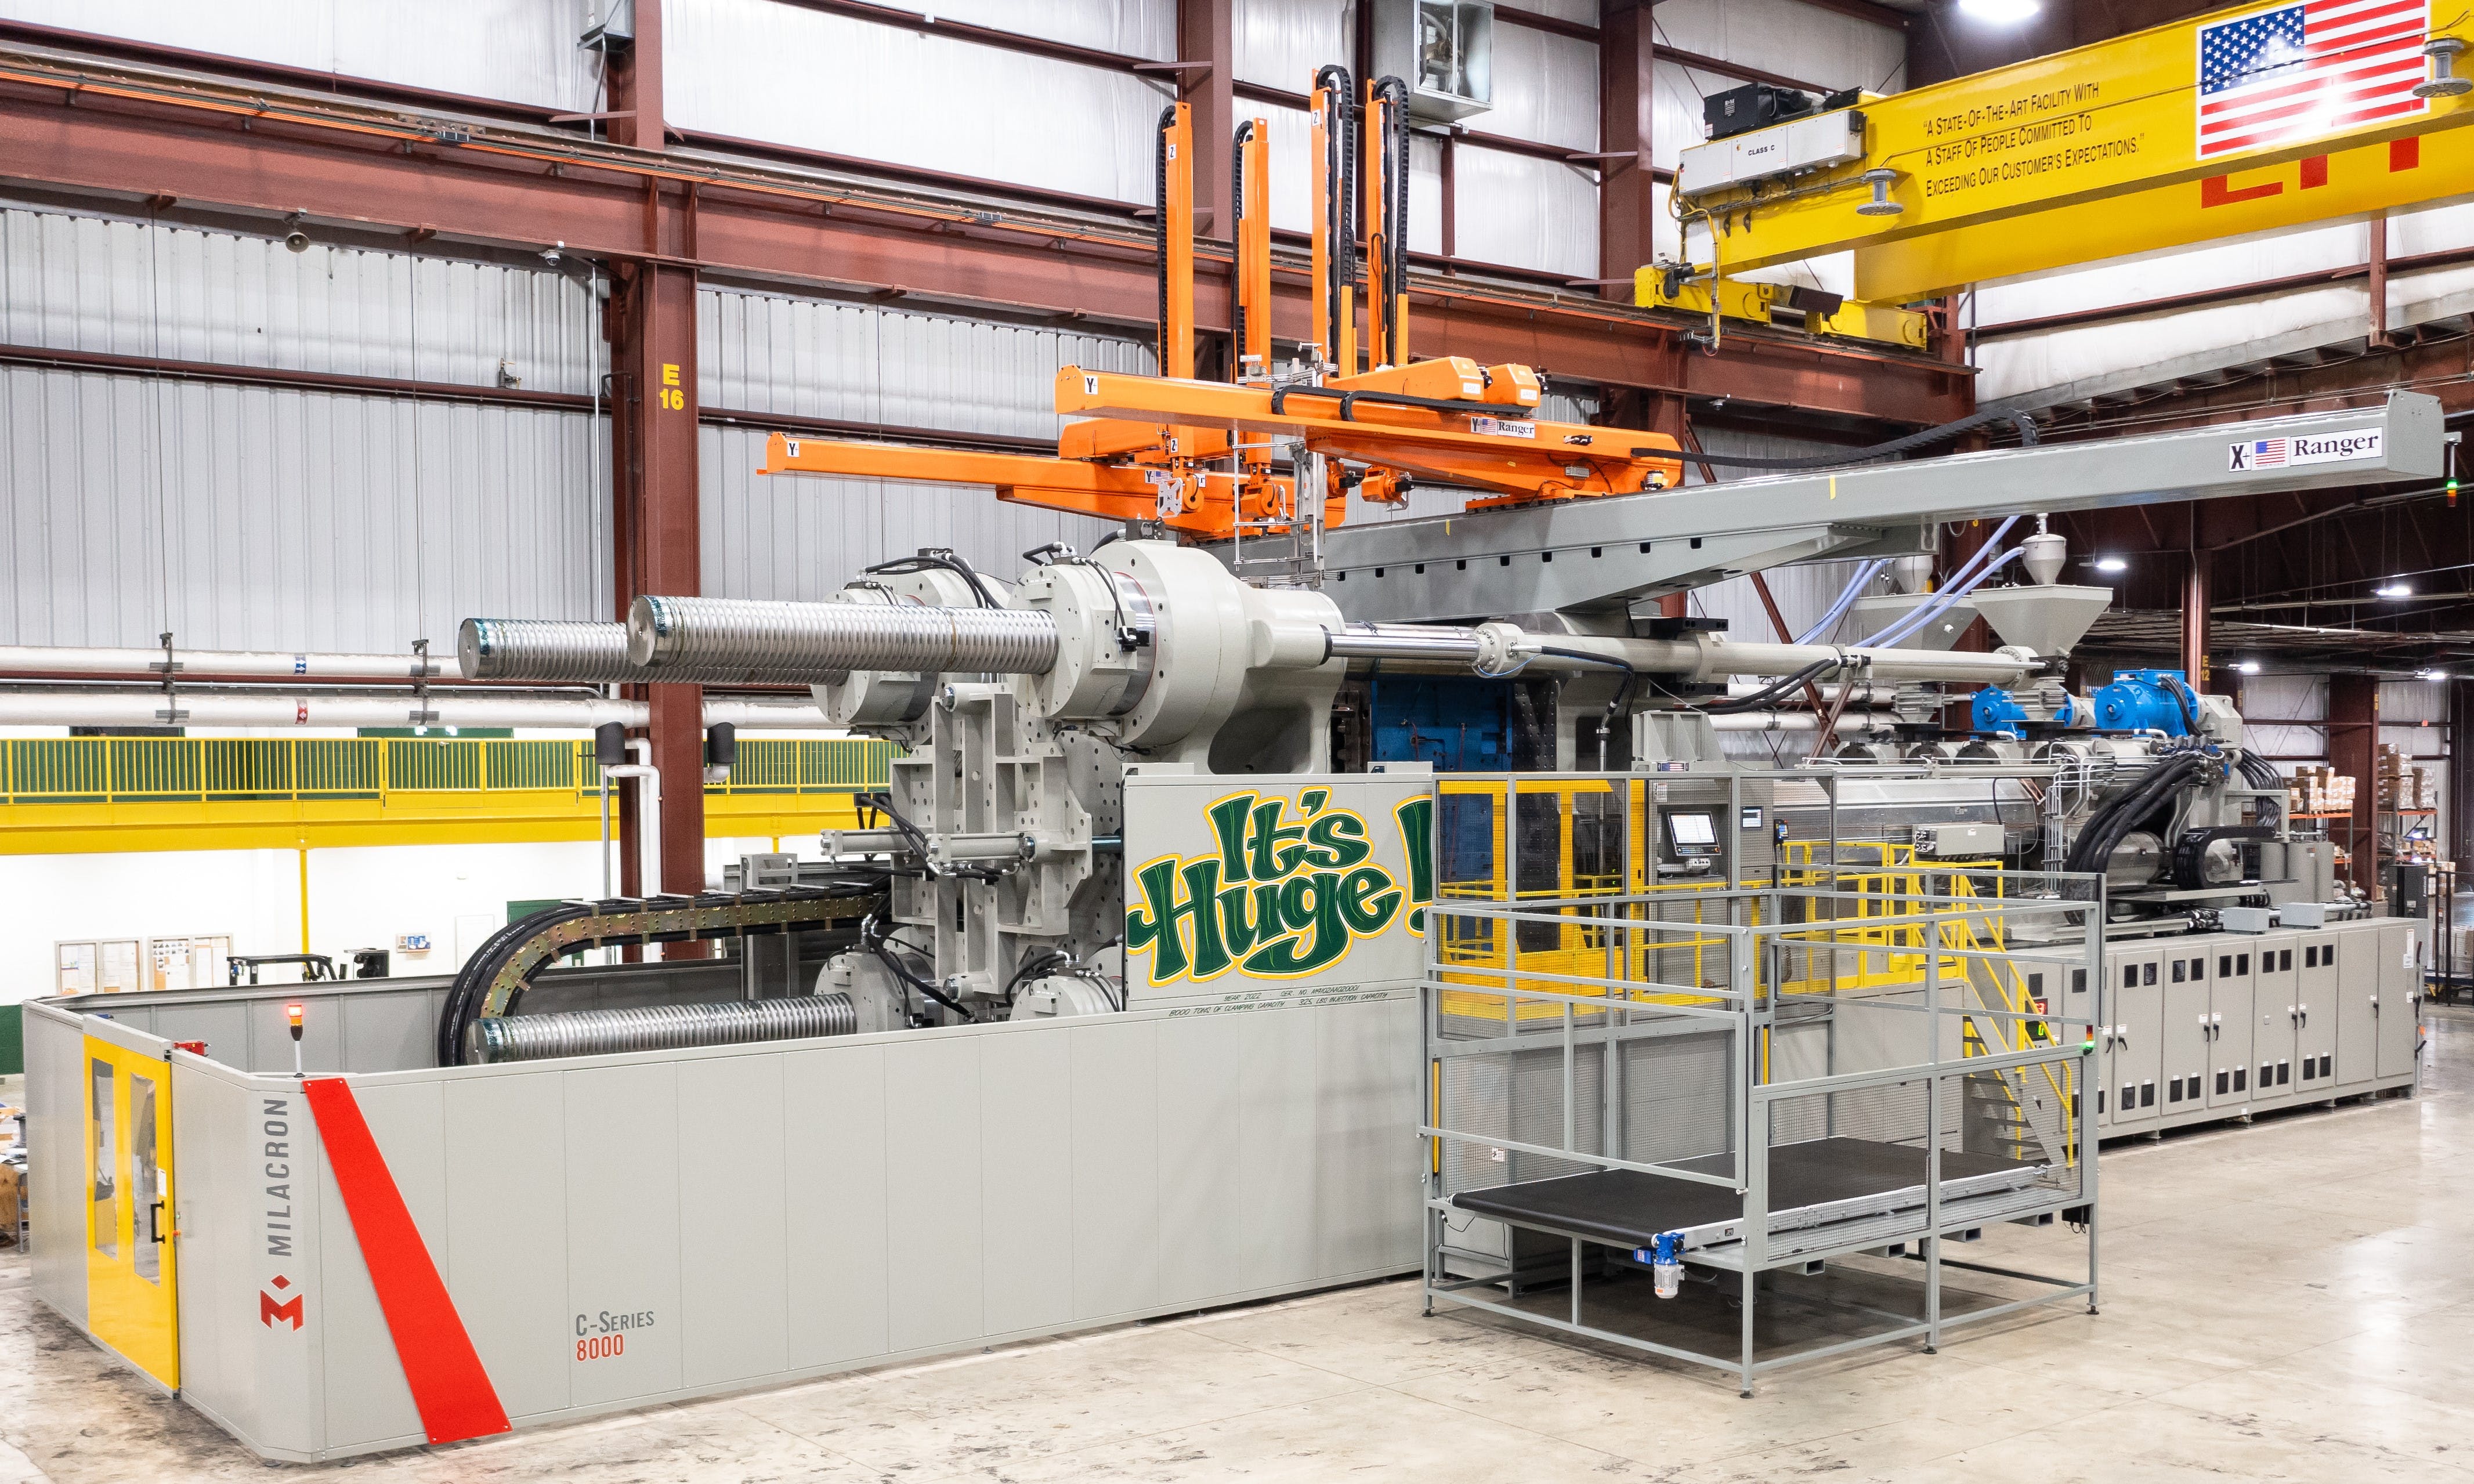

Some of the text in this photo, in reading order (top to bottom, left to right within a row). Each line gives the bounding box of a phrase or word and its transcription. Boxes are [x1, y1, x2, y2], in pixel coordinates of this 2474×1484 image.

[1937, 99, 2028, 135] STATE-OF-THE-ART
[2031, 88, 2071, 113] FACILITY
[2074, 82, 2099, 102] WITH
[1748, 146, 1768, 156] CLASS
[1926, 114, 2092, 167] A STAFF OF PEOPLE COMMITTED TO
[1926, 173, 1976, 197] EXCEEDING
[1979, 167, 1999, 186] OUR
[2002, 153, 2062, 180] CUSTOMER'S
[663, 363, 680, 386] E
[660, 388, 684, 410] 16
[1499, 422, 1534, 435] Ranger
[2295, 436, 2378, 457] Ranger
[2202, 655, 2209, 667] E
[2201, 669, 2210, 681] 12
[1207, 788, 1372, 883] It's
[1169, 1009, 1191, 1017] 8000
[1224, 1004, 1255, 1012] CLAMPING
[1257, 1001, 1286, 1009] CAPACITY
[1328, 995, 1358, 1003] INJECTION
[263, 1099, 292, 1257] MILACRON
[576, 1311, 654, 1336] C-SERIES
[576, 1333, 625, 1362] 8000
